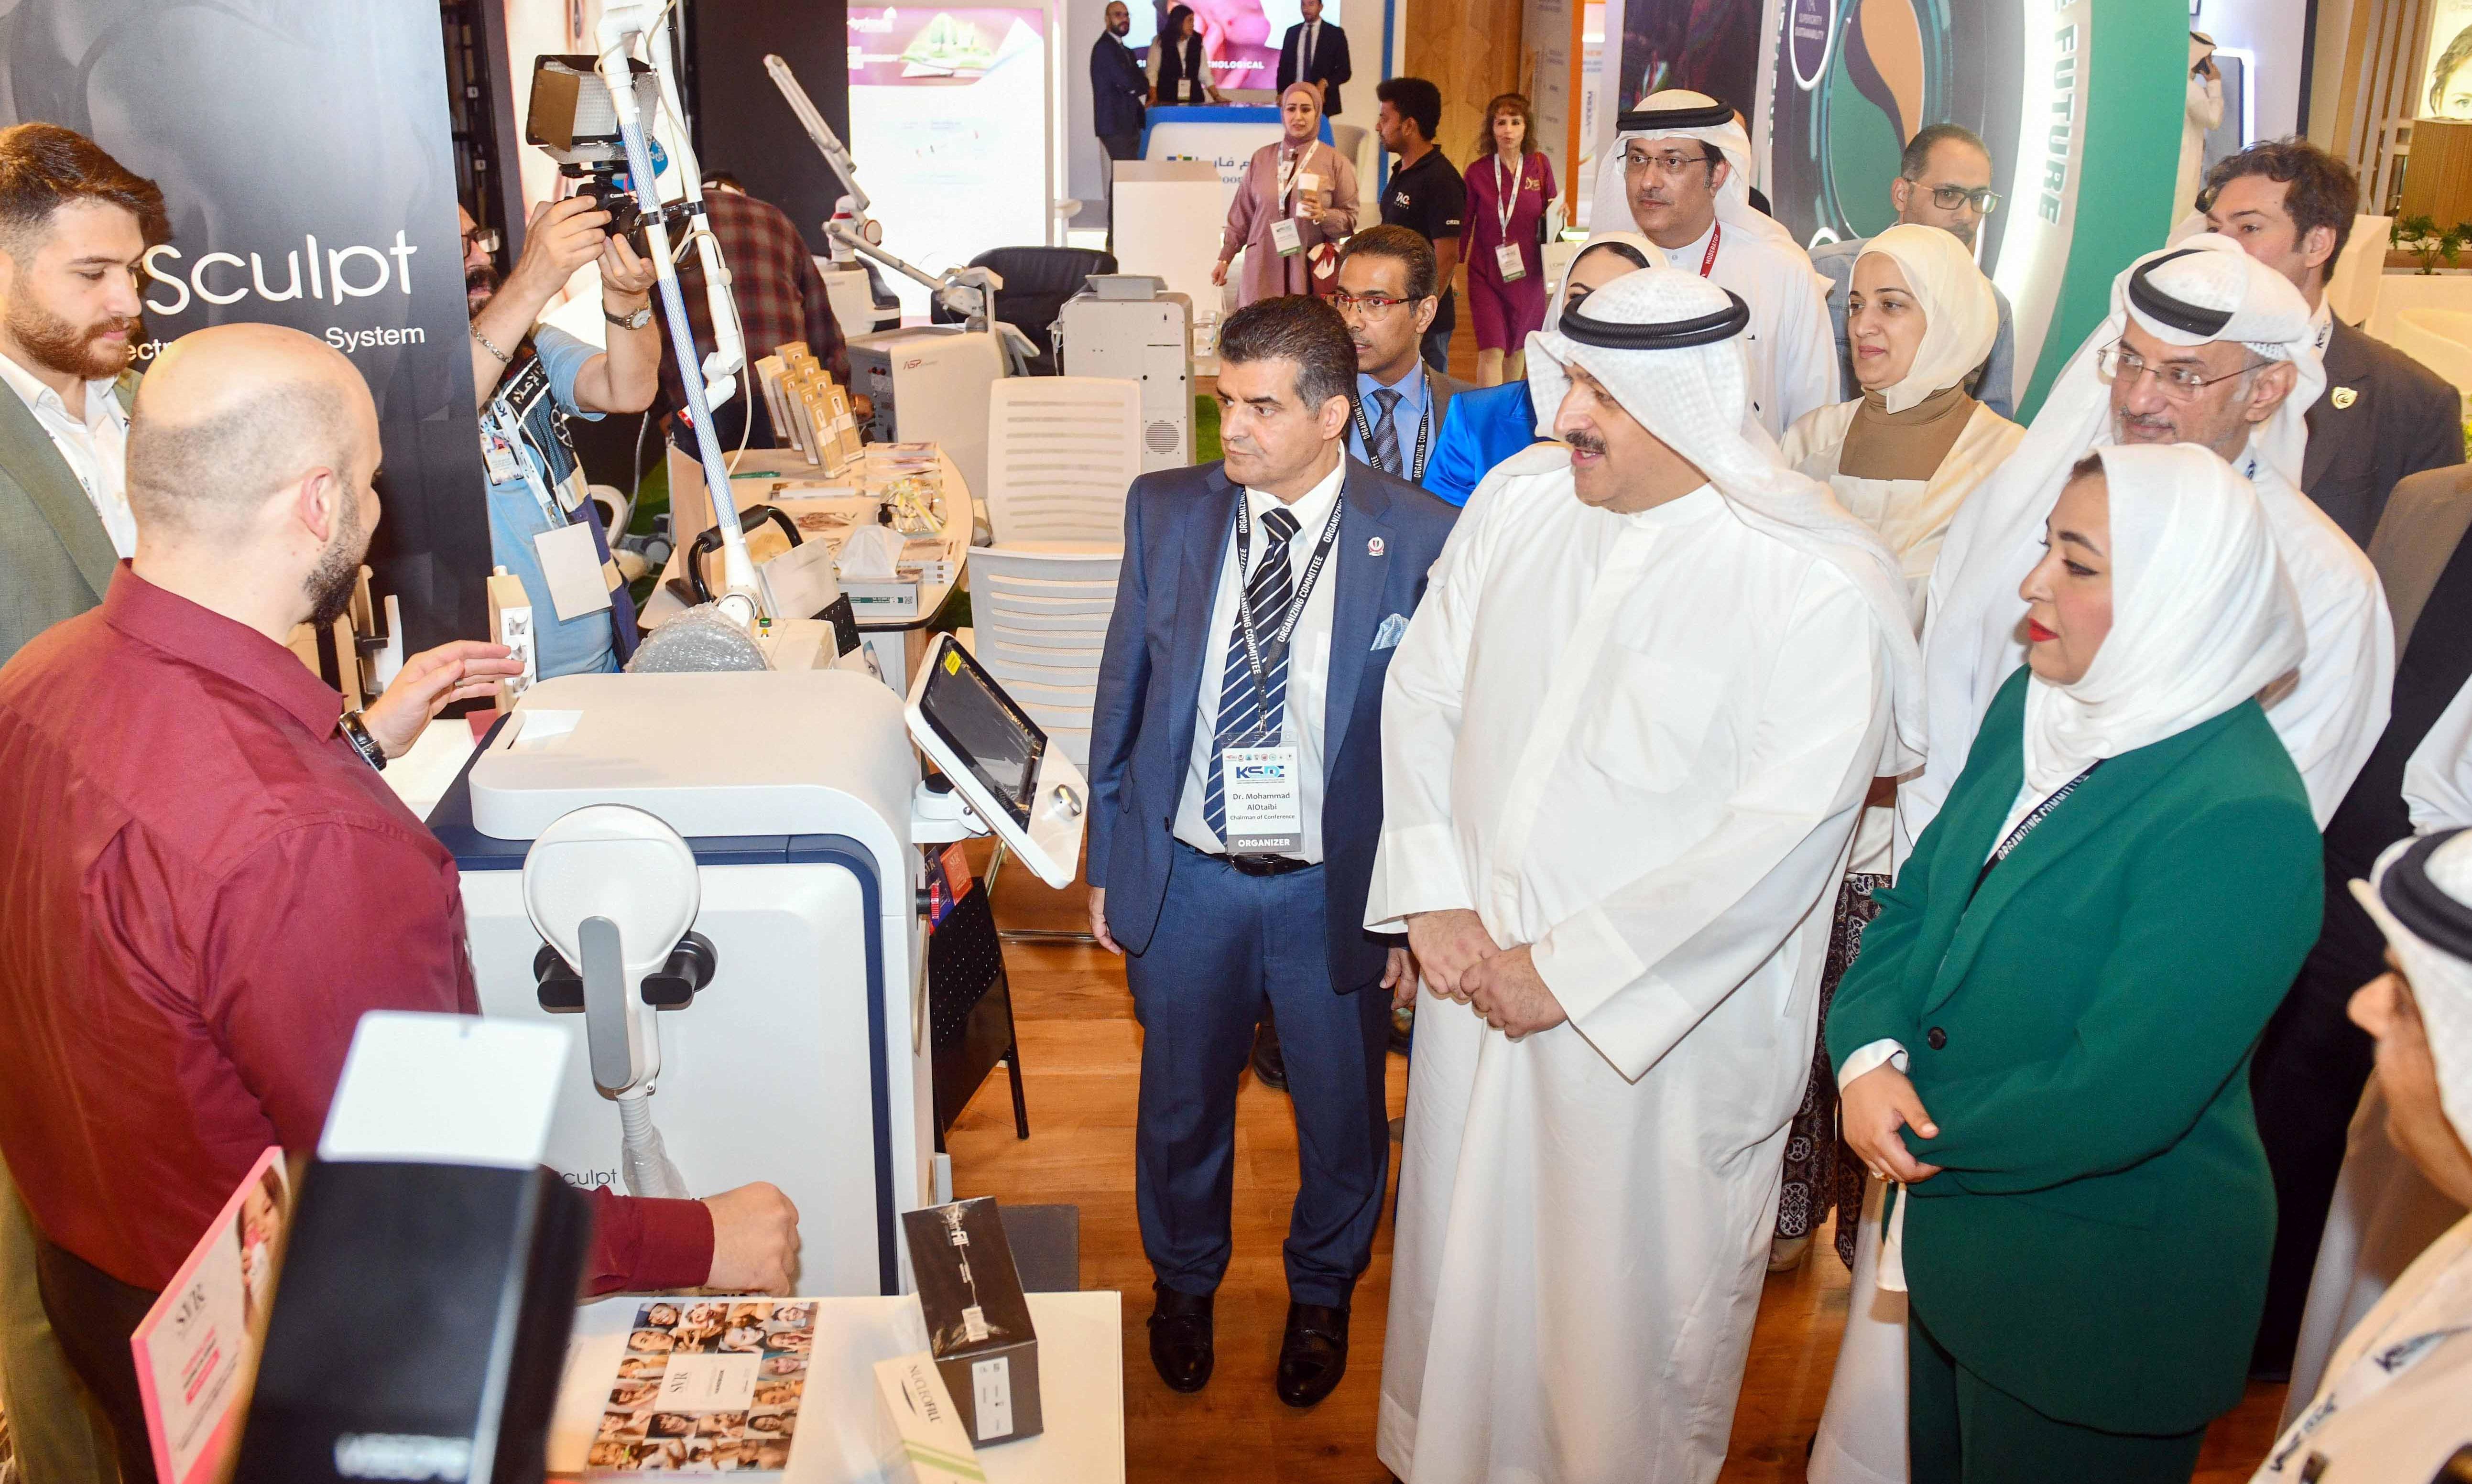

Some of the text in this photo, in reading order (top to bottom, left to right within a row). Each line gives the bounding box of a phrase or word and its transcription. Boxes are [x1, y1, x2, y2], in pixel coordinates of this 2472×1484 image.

[2038, 23, 2078, 225] FUTURE
[1705, 233, 1719, 264] MODERATOR
[142, 230, 417, 315] Sculpt
[325, 326, 425, 353] System
[1354, 407, 1370, 439] ORGANIZING
[1414, 444, 1425, 478] ORGANIZING
[1277, 555, 1324, 643] ORGANIZING COMMITTEE
[1241, 588, 1261, 675] GANIZING COMMITTEE
[1238, 839, 1290, 847] ORGANIZER
[1997, 814, 2042, 860] ORGANIZING
[563, 1169, 617, 1186] culpt
[670, 1371, 689, 1393] SVR
[910, 1365, 942, 1423] NUCLEOFILL
